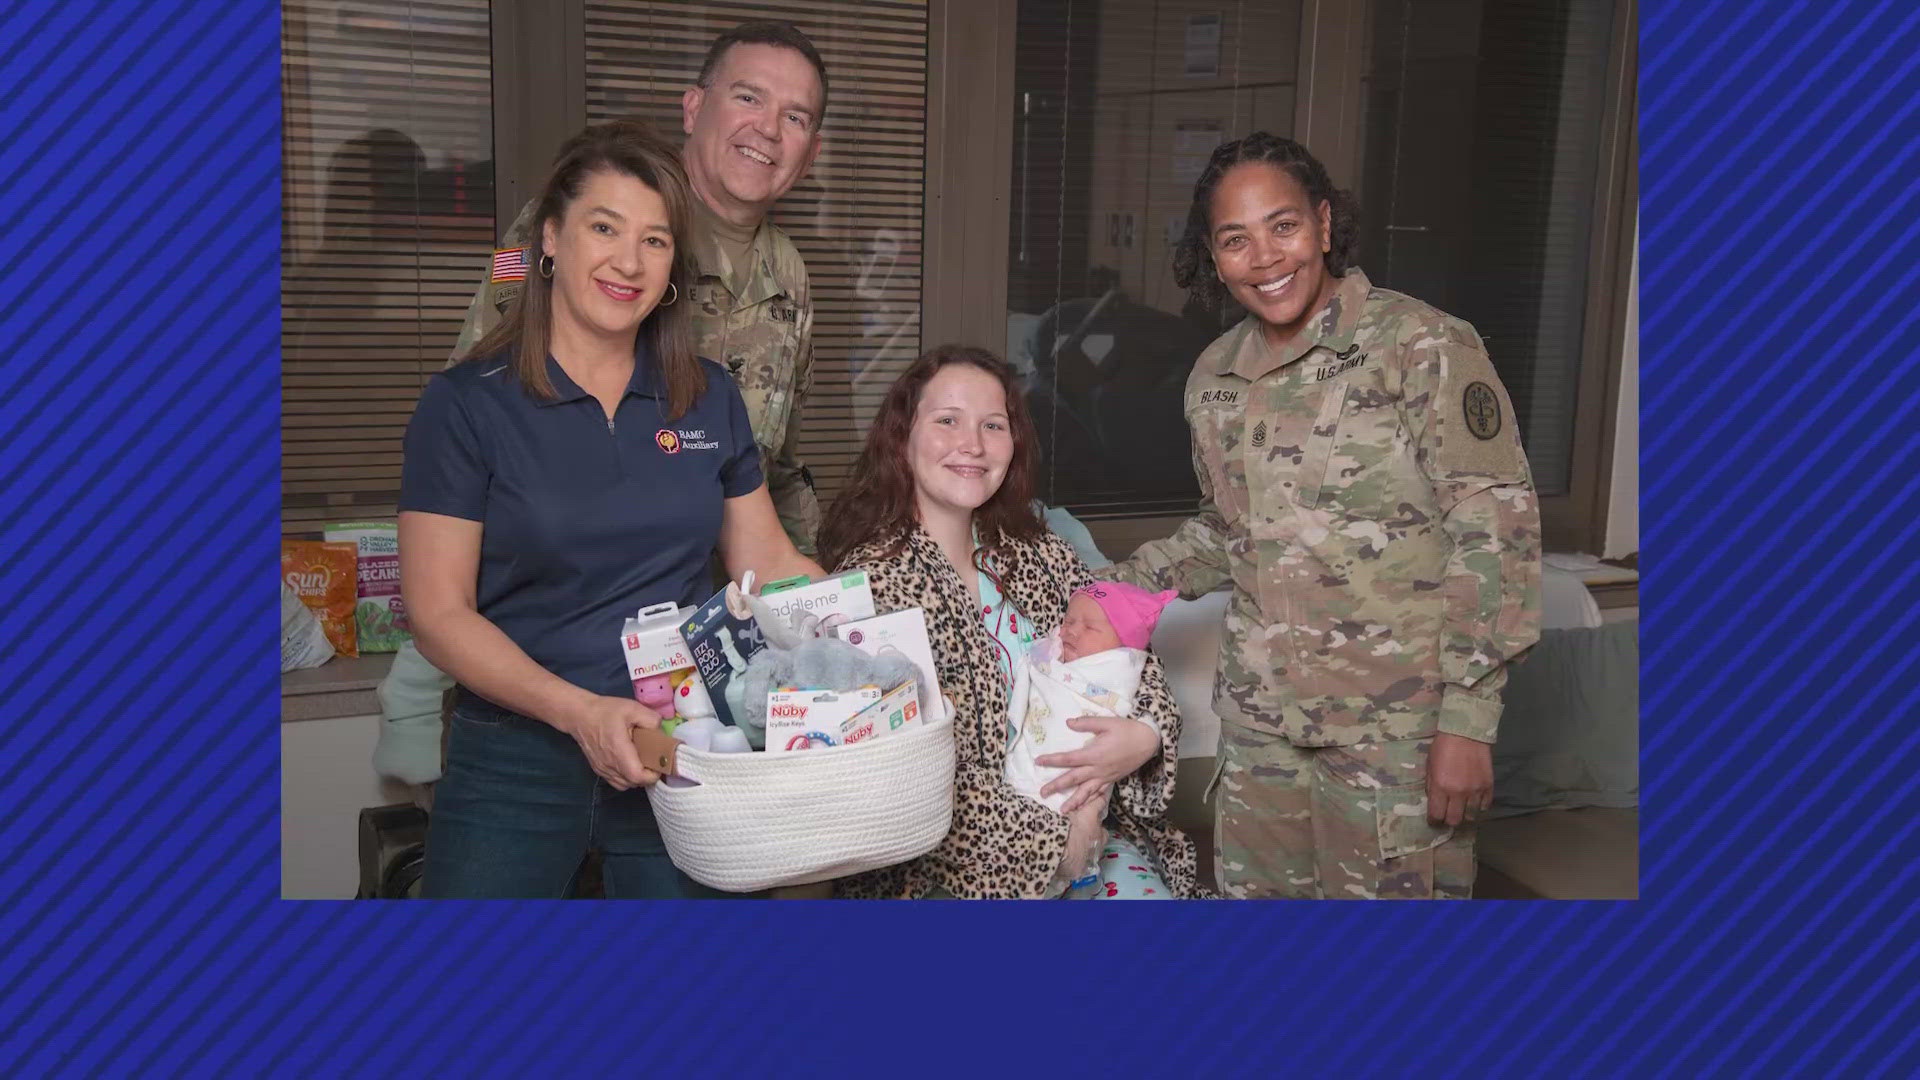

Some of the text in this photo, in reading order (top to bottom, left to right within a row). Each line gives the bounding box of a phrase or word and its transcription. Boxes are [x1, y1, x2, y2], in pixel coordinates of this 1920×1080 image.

[1201, 390, 1238, 403] BLASH
[678, 430, 705, 439] BAMC
[682, 440, 719, 449] Auxiliary
[358, 561, 399, 570] GLAZED
[300, 587, 327, 597] CHIPS
[693, 639, 709, 658] ITZY
[634, 652, 687, 676] munchkin
[698, 648, 715, 667] POD
[702, 657, 720, 676] DUO
